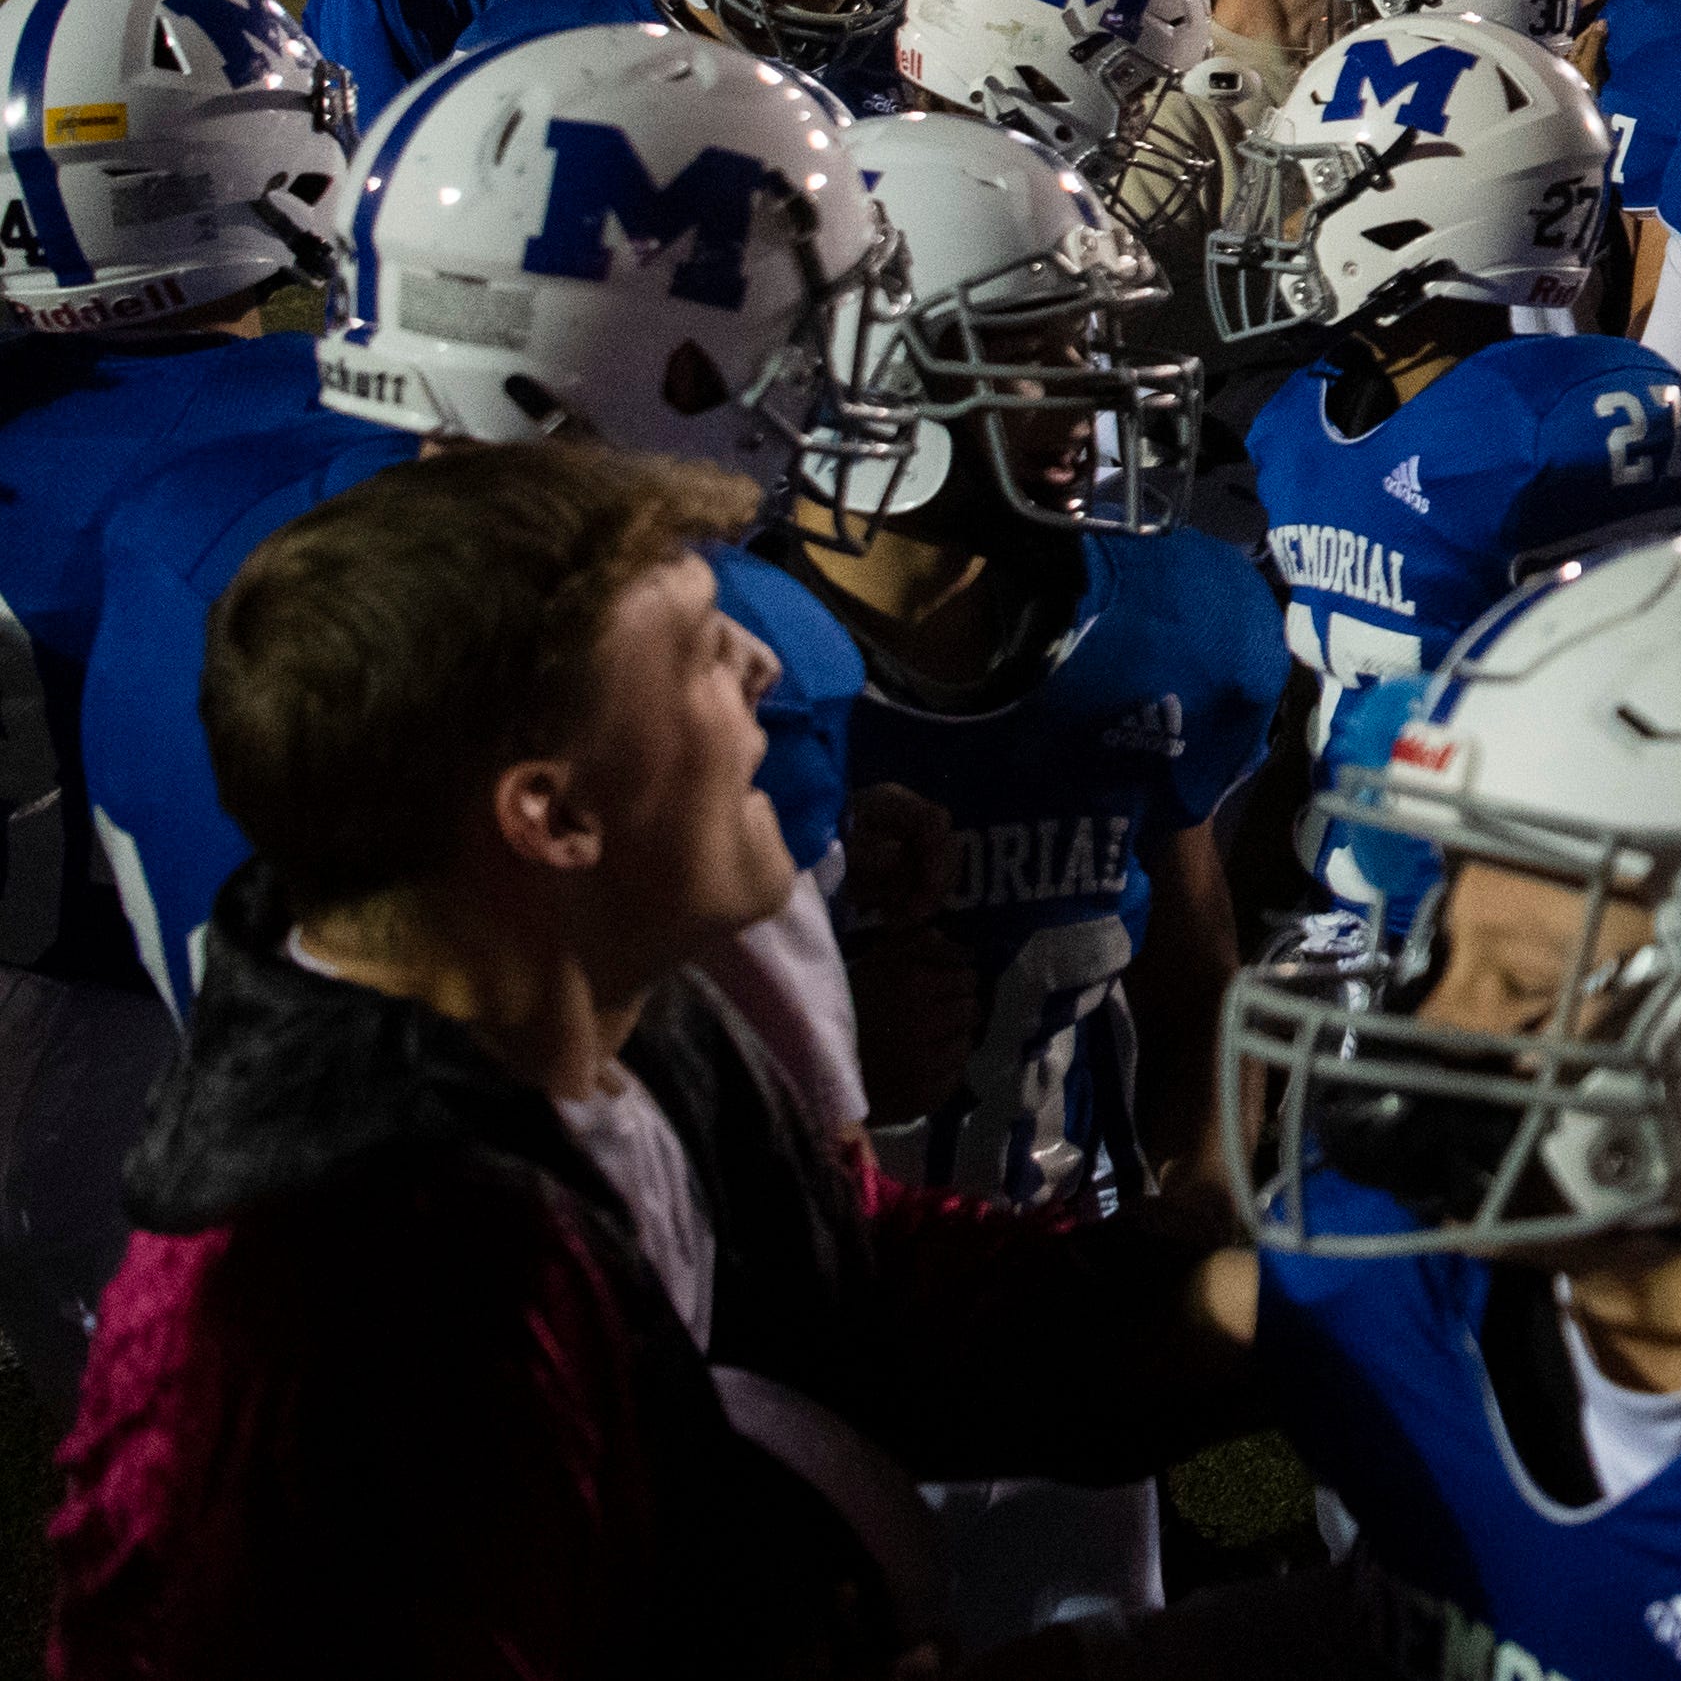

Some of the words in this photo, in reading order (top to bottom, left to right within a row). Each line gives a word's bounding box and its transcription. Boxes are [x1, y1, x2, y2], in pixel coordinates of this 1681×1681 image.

[1322, 39, 1478, 135] M
[0, 199, 49, 268] 4
[522, 118, 778, 310] M
[1530, 176, 1600, 250] 27
[1266, 523, 1417, 617] MEMORIAL
